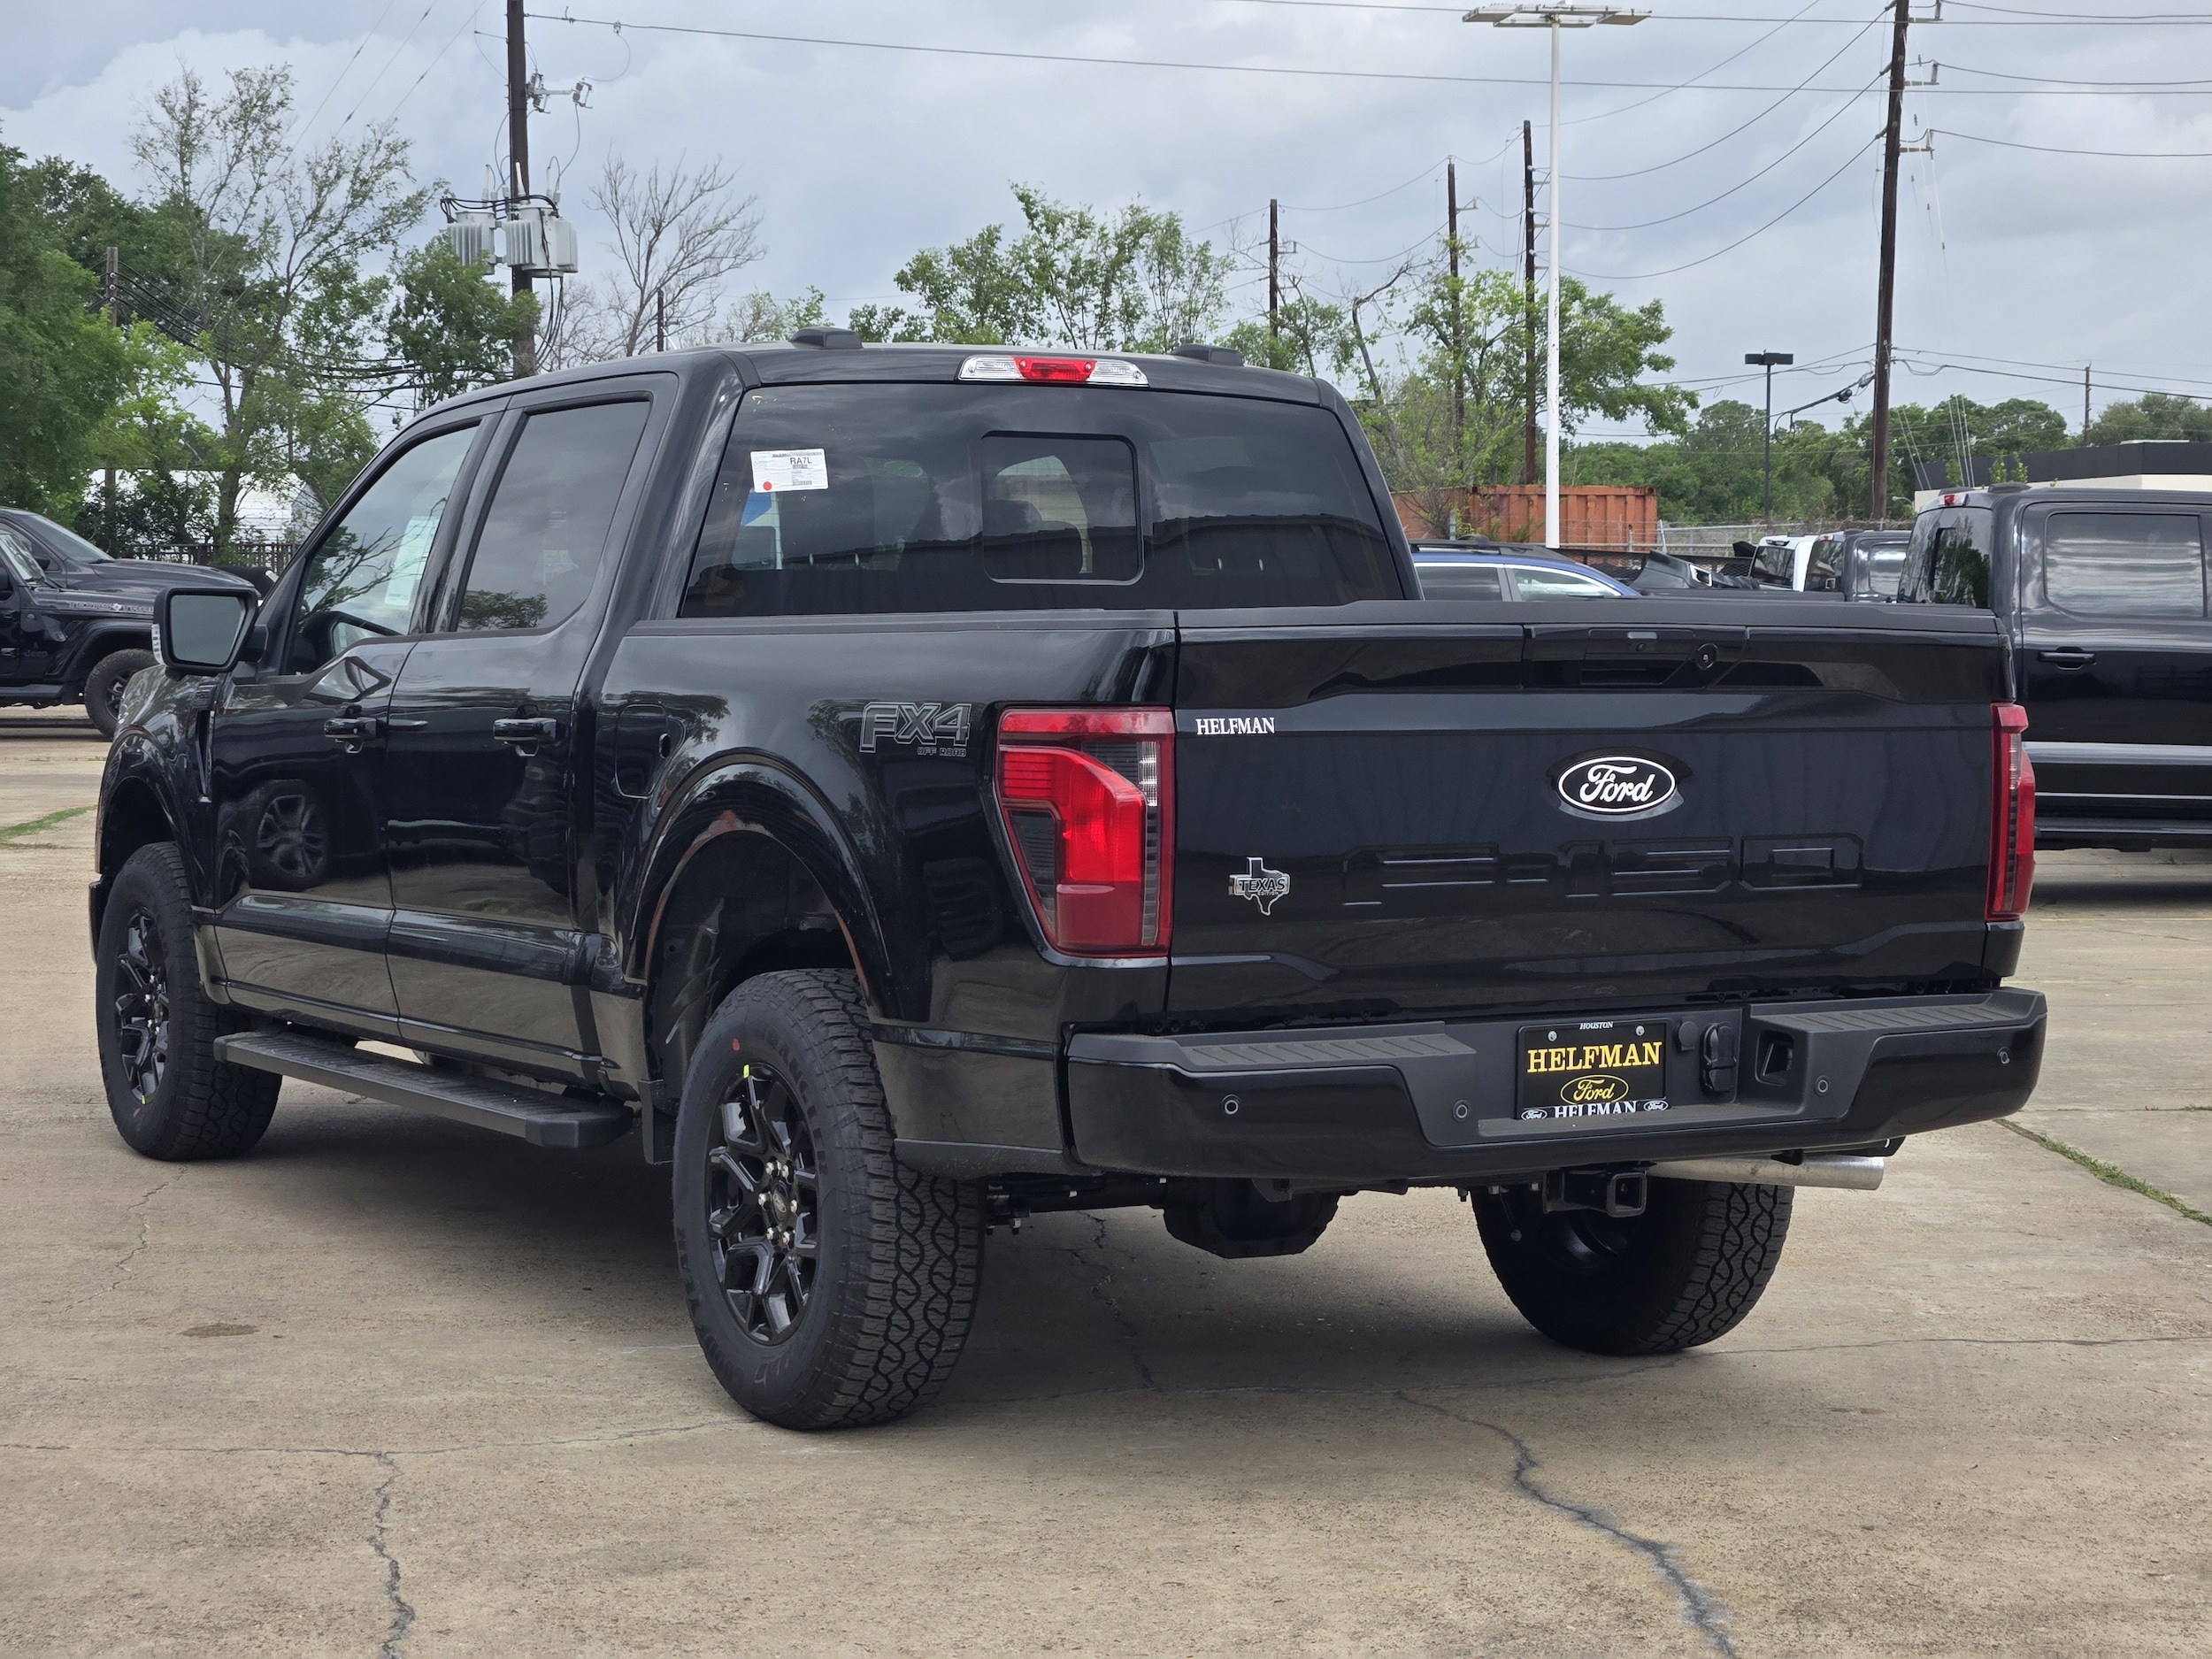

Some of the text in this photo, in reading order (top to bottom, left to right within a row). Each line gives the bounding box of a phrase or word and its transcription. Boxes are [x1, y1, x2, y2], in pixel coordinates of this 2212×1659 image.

[859, 702, 972, 753] FX4
[1195, 717, 1275, 735] HELFMAN
[918, 747, 967, 757] OFF ROAD
[1579, 764, 1656, 802] Ford
[1239, 878, 1286, 892] TEXAS
[1579, 1021, 1614, 1030] HOUSTON
[1527, 1041, 1663, 1073] HELFMAN
[1573, 1079, 1616, 1101] Ford
